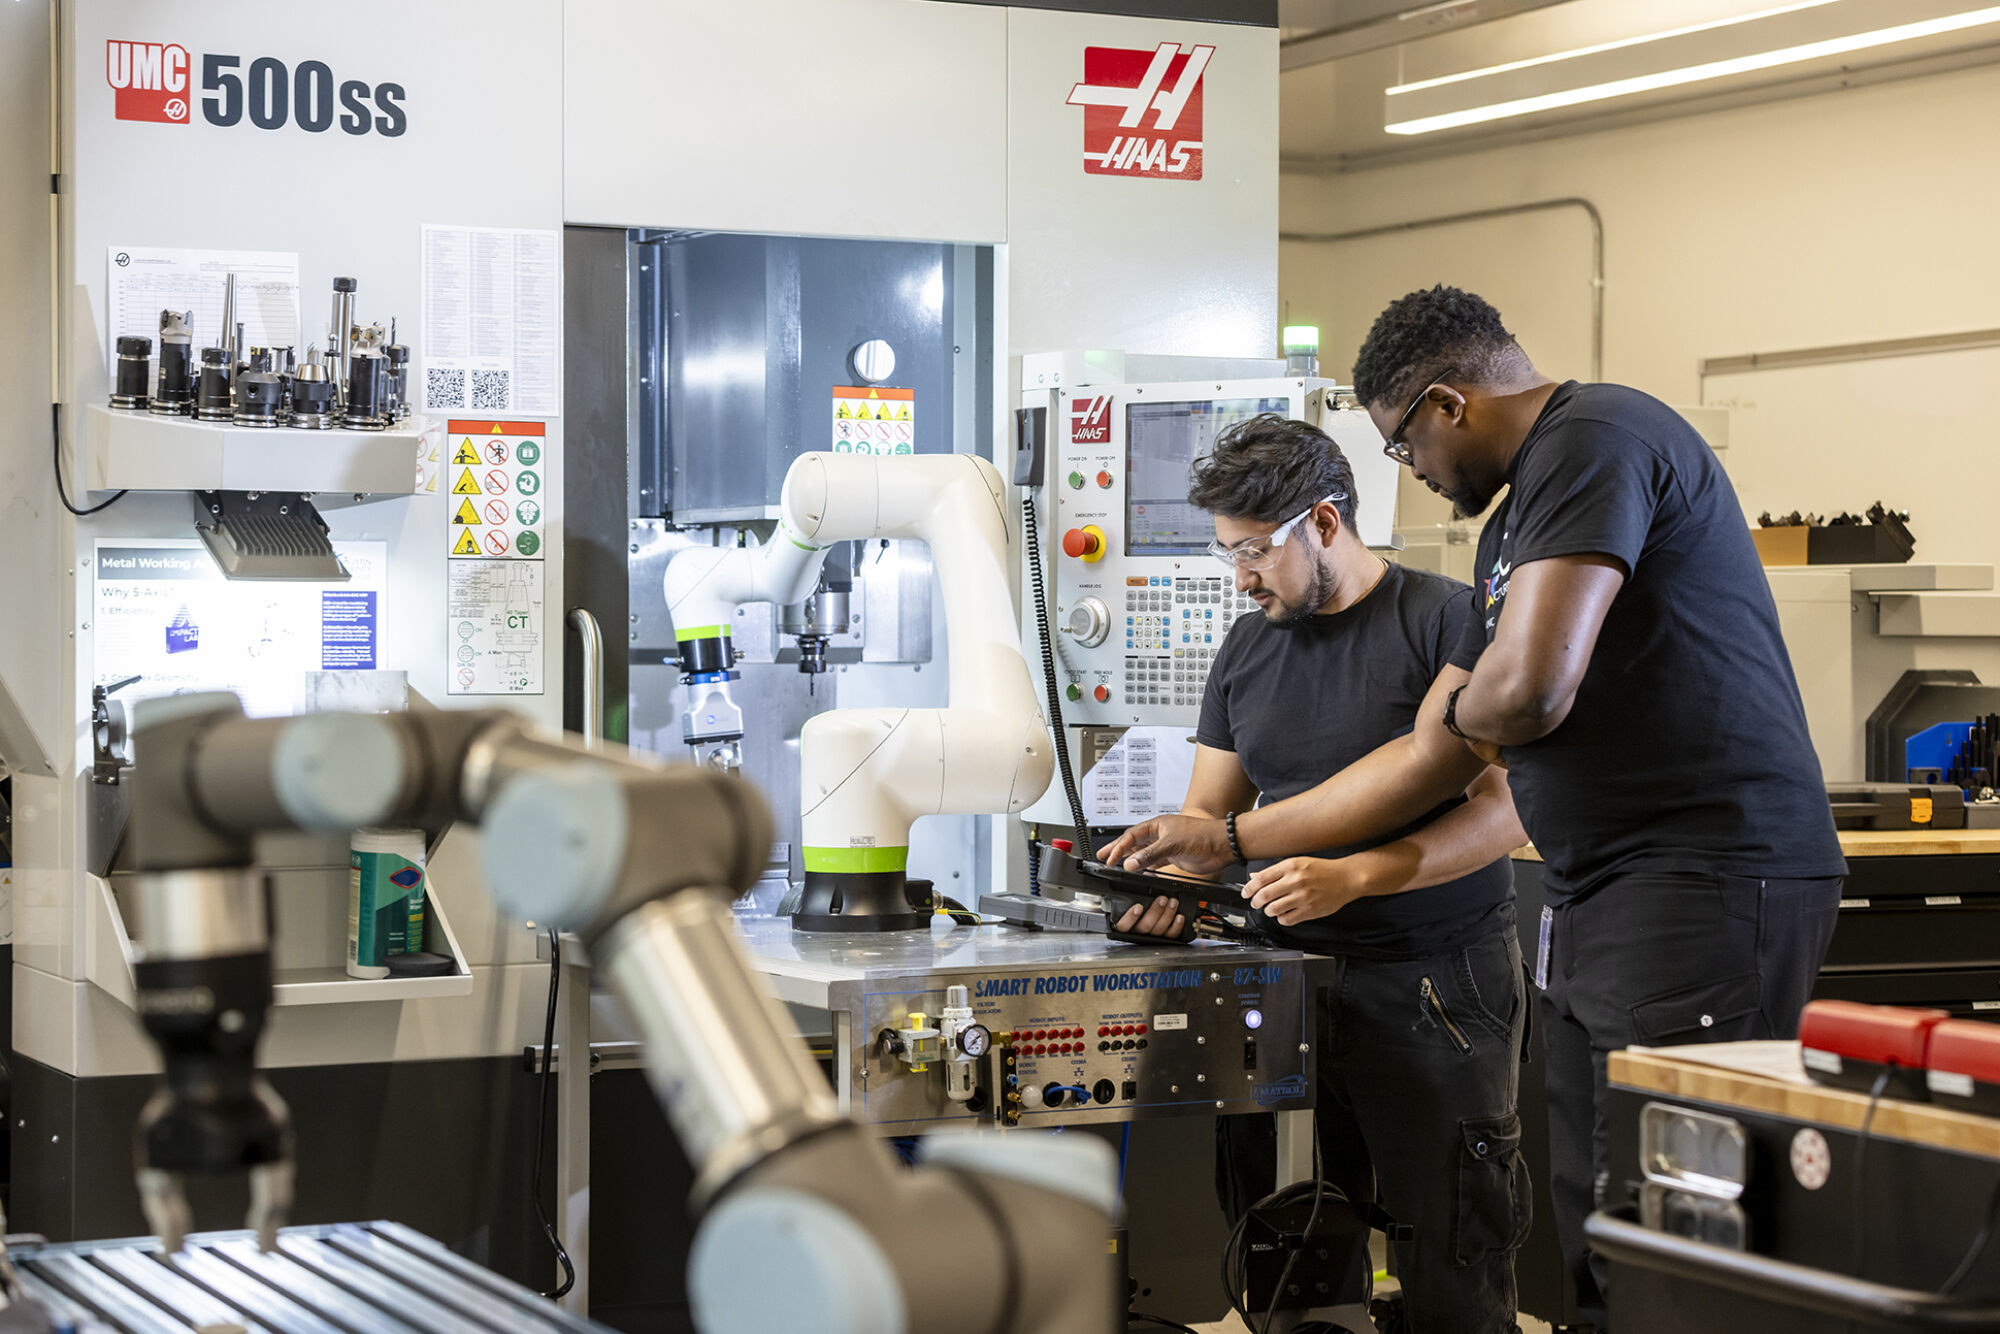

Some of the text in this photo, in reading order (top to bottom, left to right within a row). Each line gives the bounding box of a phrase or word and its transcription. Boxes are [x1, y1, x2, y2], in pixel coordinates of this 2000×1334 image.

[107, 41, 187, 92] UMC
[1084, 136, 1203, 173] HAAS
[1072, 427, 1107, 440] HAAS
[102, 557, 136, 568] Metal
[138, 558, 192, 571] Working
[101, 587, 130, 599] Why
[507, 615, 529, 629] CT
[975, 967, 1283, 998] SMART ROBOT WORKSTATION 87-SW
